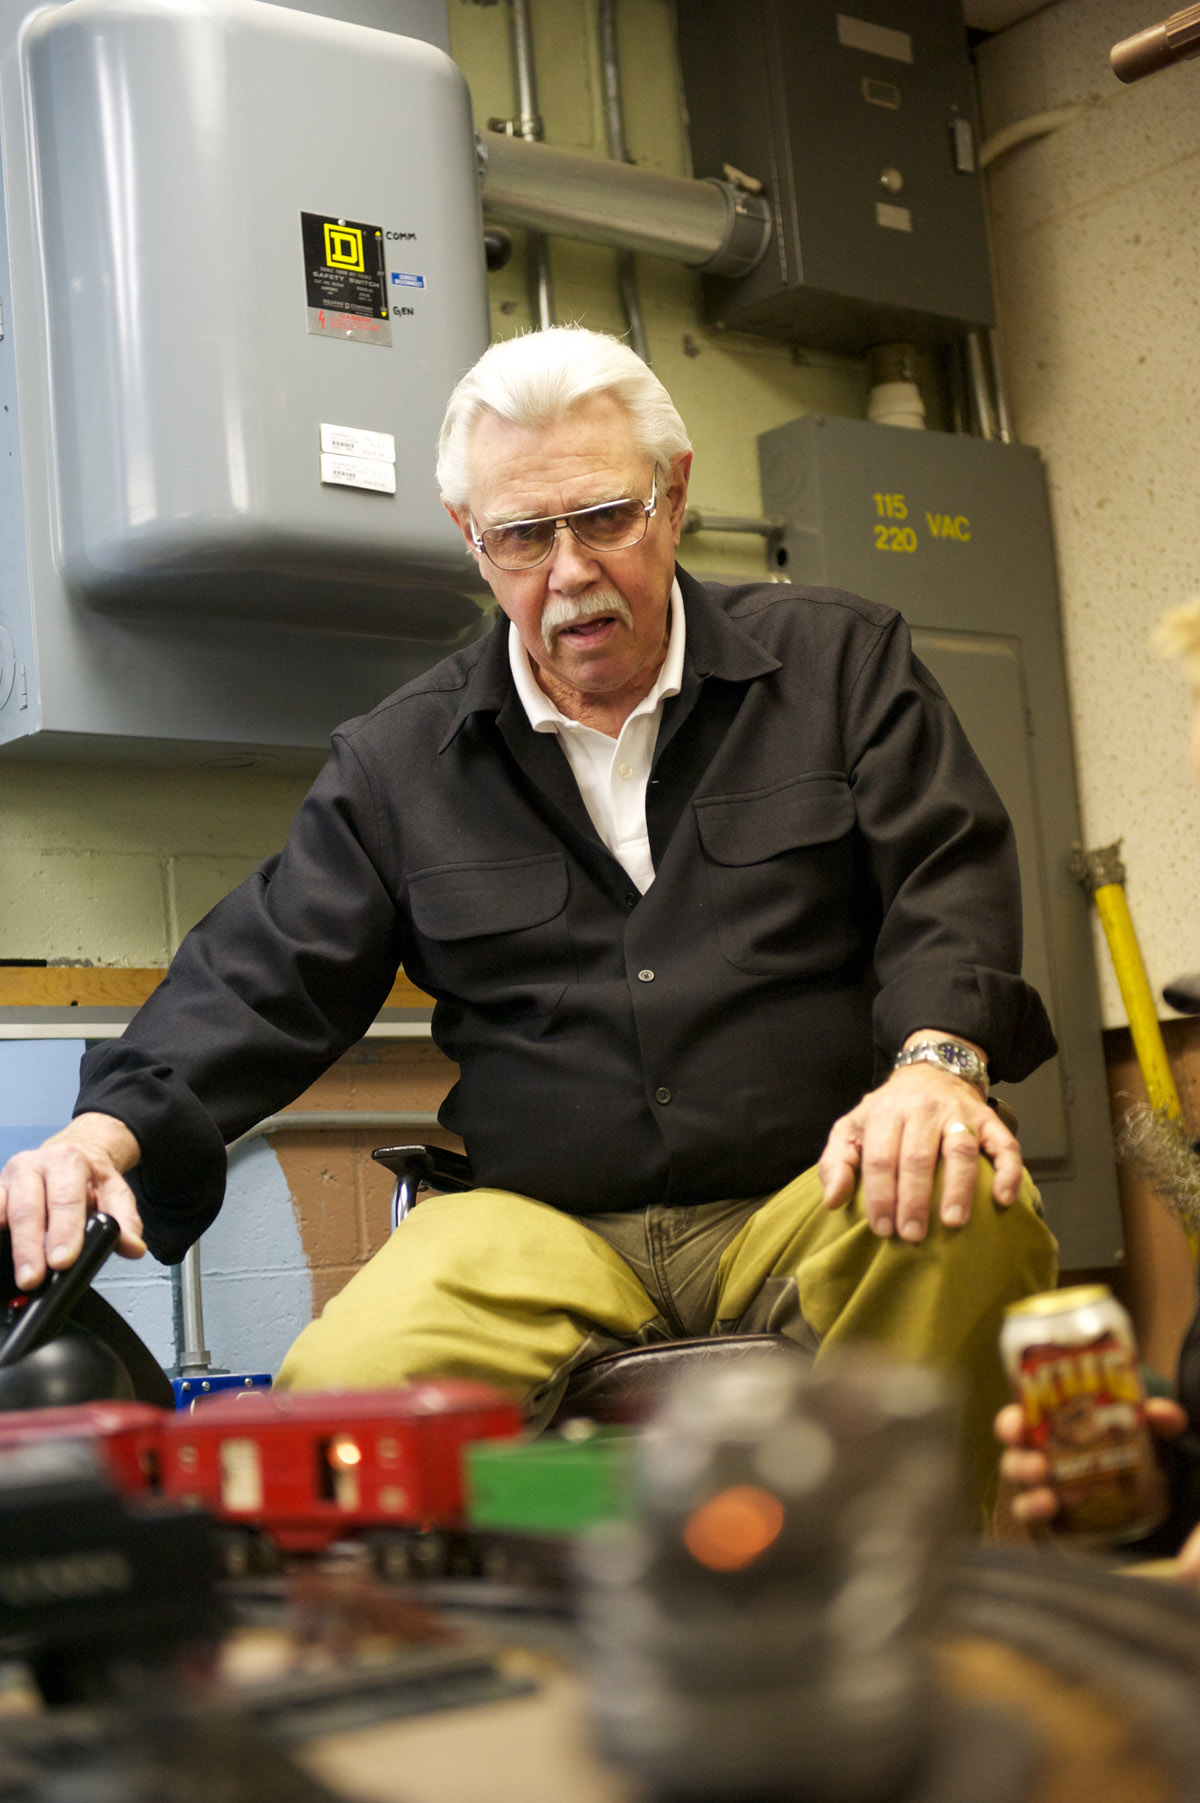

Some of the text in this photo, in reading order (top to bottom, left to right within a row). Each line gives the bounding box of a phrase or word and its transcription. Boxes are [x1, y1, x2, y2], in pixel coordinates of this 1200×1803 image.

[385, 231, 417, 241] COMM
[312, 271, 345, 282] SAFETY
[348, 277, 380, 288] SWITCH
[392, 306, 414, 317] GEN
[873, 492, 908, 520] 115
[925, 511, 972, 542] VAC
[874, 524, 918, 553] 220
